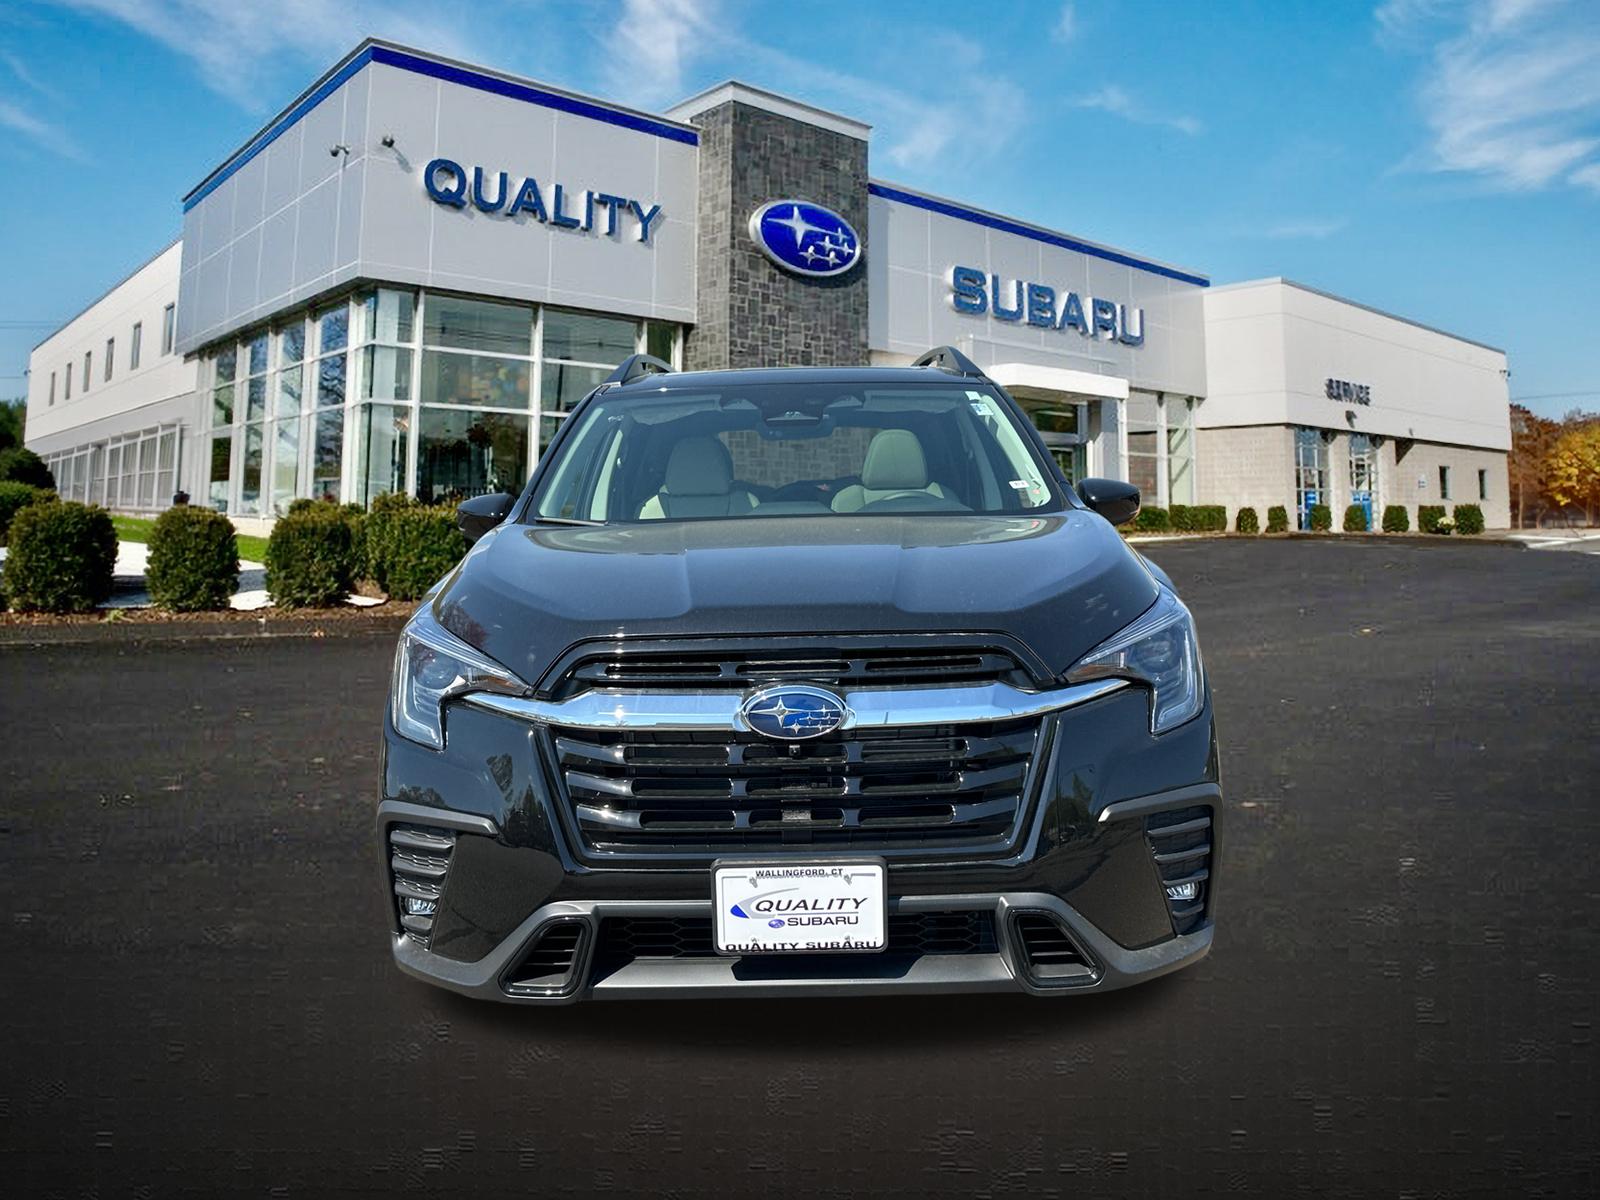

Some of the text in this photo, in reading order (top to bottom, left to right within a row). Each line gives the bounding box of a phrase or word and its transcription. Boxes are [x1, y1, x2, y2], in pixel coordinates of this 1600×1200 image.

[424, 158, 661, 242] QUALITY
[952, 265, 1144, 346] SUBARU
[1325, 378, 1370, 406] SERVICE
[831, 868, 843, 876] CT
[755, 897, 868, 912] QUALITY
[787, 916, 859, 926] SUBARU
[725, 941, 878, 952] QUALITY SUBARU
